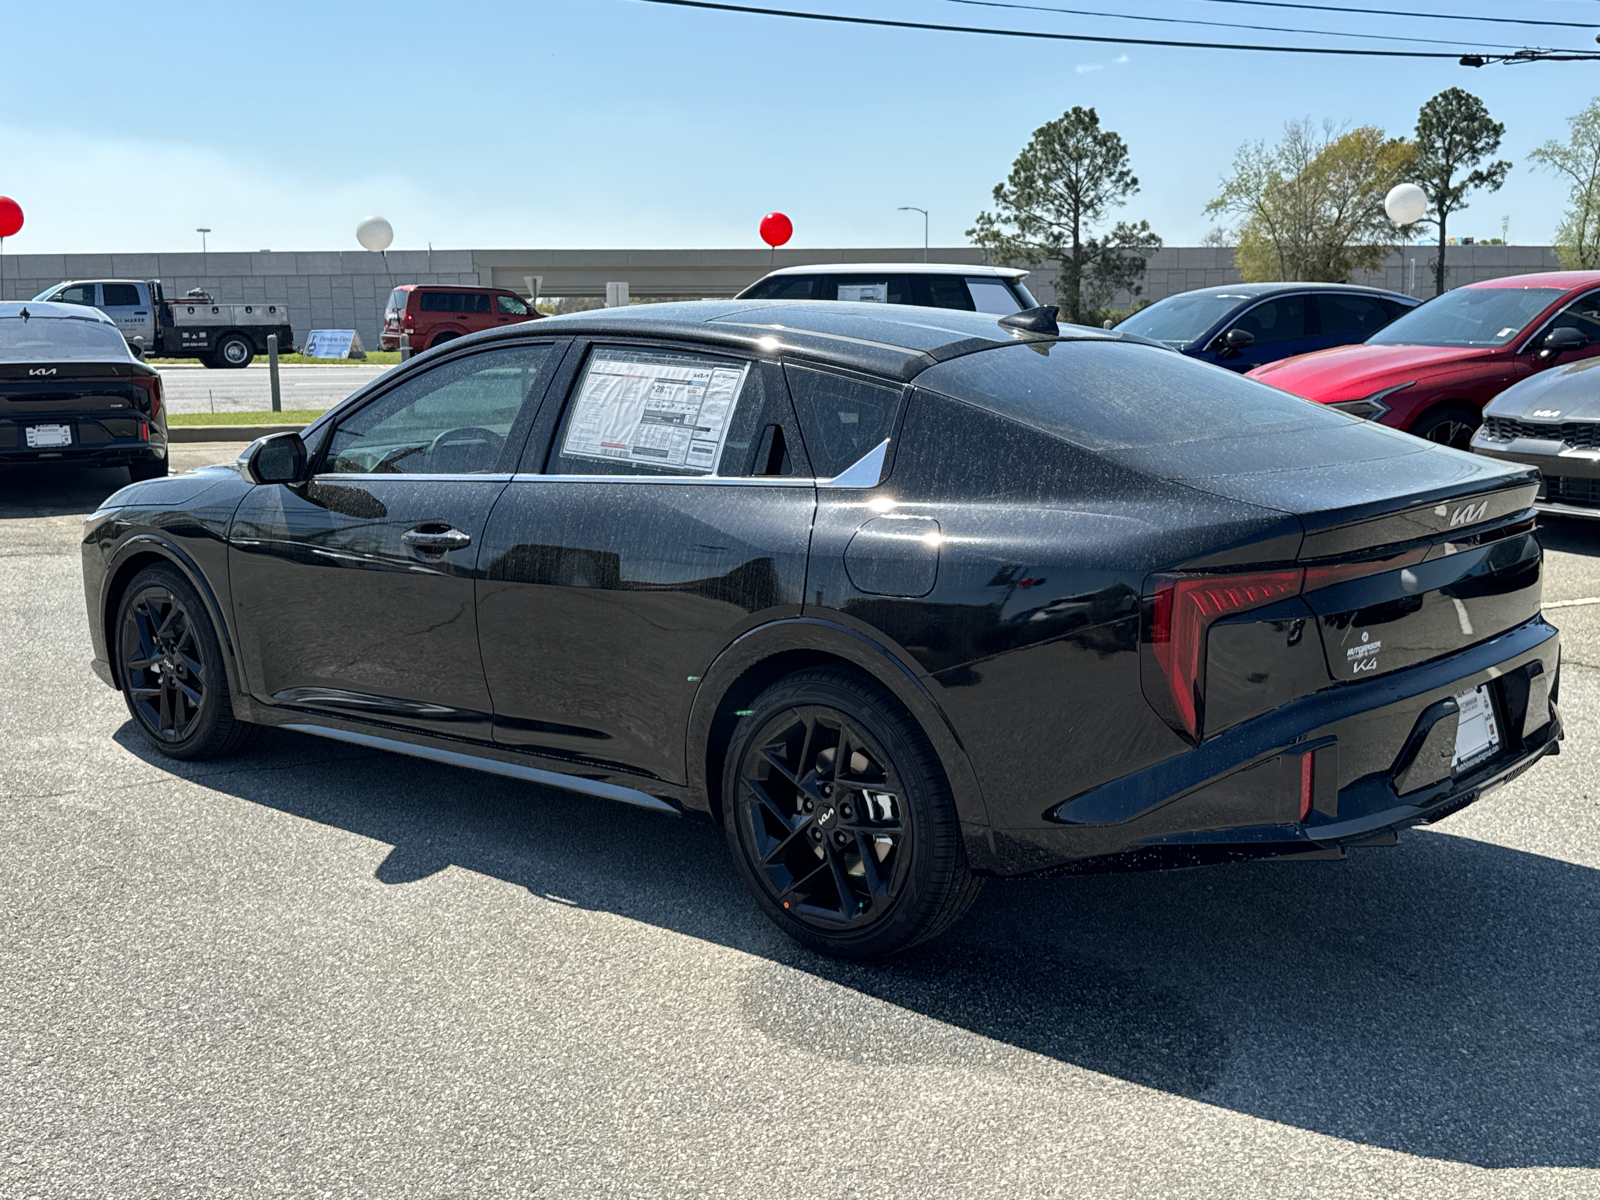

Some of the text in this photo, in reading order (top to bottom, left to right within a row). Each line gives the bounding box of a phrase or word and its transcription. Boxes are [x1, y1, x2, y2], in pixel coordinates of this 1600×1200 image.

[29, 368, 57, 376] KIA
[1533, 409, 1561, 418] KIA
[1450, 500, 1488, 526] KIA
[164, 657, 174, 670] KIA
[1353, 657, 1377, 673] K4
[818, 807, 834, 826] KIA
